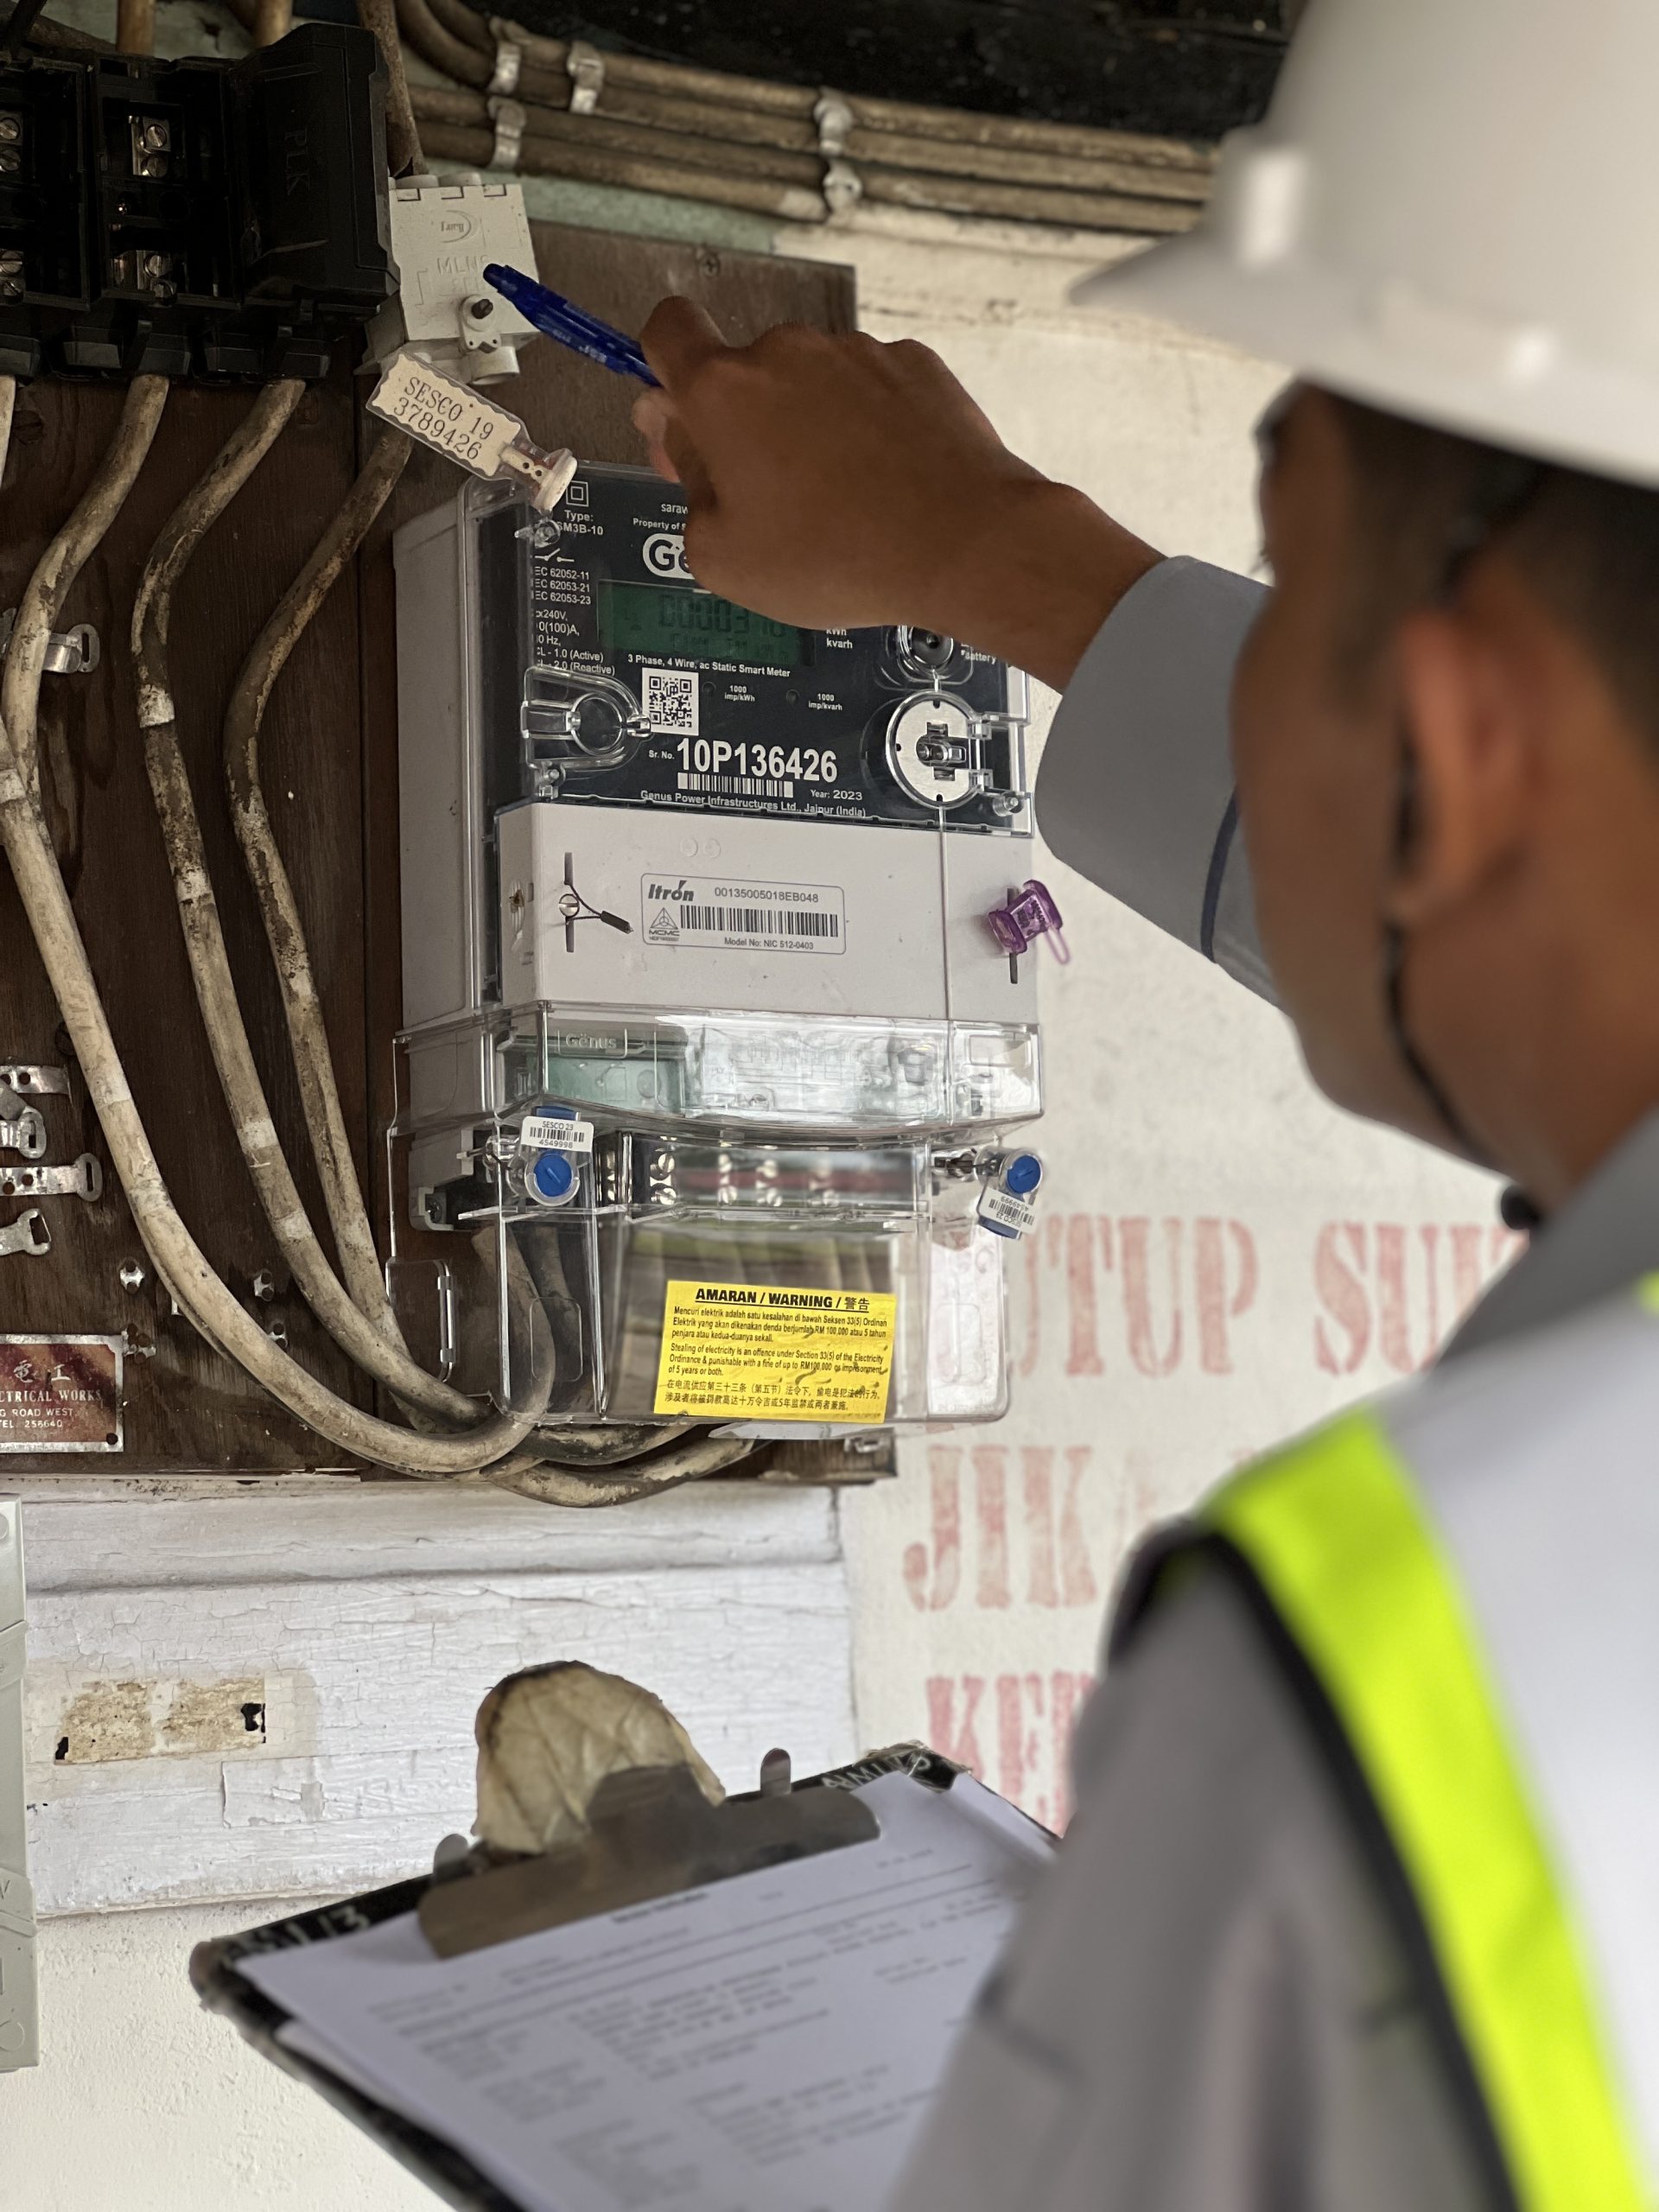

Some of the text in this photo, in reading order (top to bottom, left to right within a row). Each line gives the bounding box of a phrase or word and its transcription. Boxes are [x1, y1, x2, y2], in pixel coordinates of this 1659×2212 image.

[403, 377, 493, 440] SESCO 19
[393, 397, 482, 460] 3789426
[564, 510, 594, 522] Type:
[632, 518, 669, 531] Property
[550, 568, 590, 580] 62052-11
[550, 580, 590, 593] 62053-21
[550, 591, 591, 604] 62053-23
[826, 638, 853, 649] kvarh
[554, 648, 568, 658] 1.0
[570, 649, 604, 663] (Active)
[570, 662, 615, 676] (Reactive)
[628, 654, 633, 663] 3
[635, 655, 665, 667] Phase,
[667, 658, 673, 666] 4
[674, 659, 697, 670] Wire,
[712, 661, 737, 672] Static
[739, 664, 765, 675] Smart
[766, 667, 791, 677] Meter
[729, 685, 747, 693] 1000
[724, 692, 756, 702] imp/kWh
[817, 693, 835, 702] 1000
[808, 701, 843, 711] imp/kvarh
[648, 737, 838, 783] Sr. No. 10P136426
[810, 789, 863, 801] Year: 2023
[640, 790, 673, 802] Genus
[675, 792, 706, 804] Power
[708, 795, 778, 810] Infrastructures
[804, 803, 834, 815] Jaipur
[836, 805, 866, 818] (India)
[715, 887, 819, 903] 00135005018EB048
[724, 937, 814, 950] Model No: NIC 512-0403
[542, 1120, 564, 1129] SESCO
[539, 1139, 574, 1149] 4549998
[695, 1288, 870, 1310] AMARAN / WARNING / 警告
[674, 1306, 699, 1315] Mencuri
[701, 1308, 723, 1316] elektrik
[762, 1312, 793, 1321] kesalahan
[795, 1313, 801, 1322] di
[802, 1314, 821, 1323] bawah
[823, 1315, 845, 1324] Seksen
[847, 1316, 862, 1327] 33(5)
[864, 1318, 887, 1327] Ordinan
[673, 1317, 696, 1327] Elektrik
[698, 1320, 713, 1329] yang
[731, 1321, 762, 1331] dikenakan
[763, 1322, 782, 1332] denda
[783, 1324, 813, 1334] berjumlah
[814, 1325, 825, 1334] RM
[826, 1326, 849, 1336] 100,000
[864, 1328, 868, 1337] 5
[869, 1329, 886, 1338] tahun
[672, 1330, 695, 1339] penjara
[711, 1331, 753, 1342] kedua-duanya
[754, 1333, 773, 1342] sekali.
[671, 1343, 696, 1354] Stealing
[697, 1344, 705, 1353] of
[705, 1345, 736, 1356] electricity
[753, 1348, 775, 1357] offence
[776, 1350, 795, 1358] under
[795, 1350, 819, 1359] Section
[820, 1351, 835, 1361] 33(5)
[836, 1352, 842, 1361] of
[843, 1353, 852, 1361] the
[854, 1353, 884, 1364] Electricity
[670, 1354, 701, 1364] Ordinance
[702, 1356, 707, 1364] &
[709, 1356, 742, 1367] punishable
[743, 1358, 756, 1367] with
[762, 1359, 773, 1368] fine
[775, 1360, 782, 1368] of
[800, 1361, 832, 1371] RM100,000
[668, 1365, 675, 1373] of
[676, 1365, 680, 1373] 5
[681, 1367, 698, 1376] years
[708, 1367, 724, 1376] both.
[12, 1408, 41, 1417] ROAD
[46, 1408, 74, 1417] WEST
